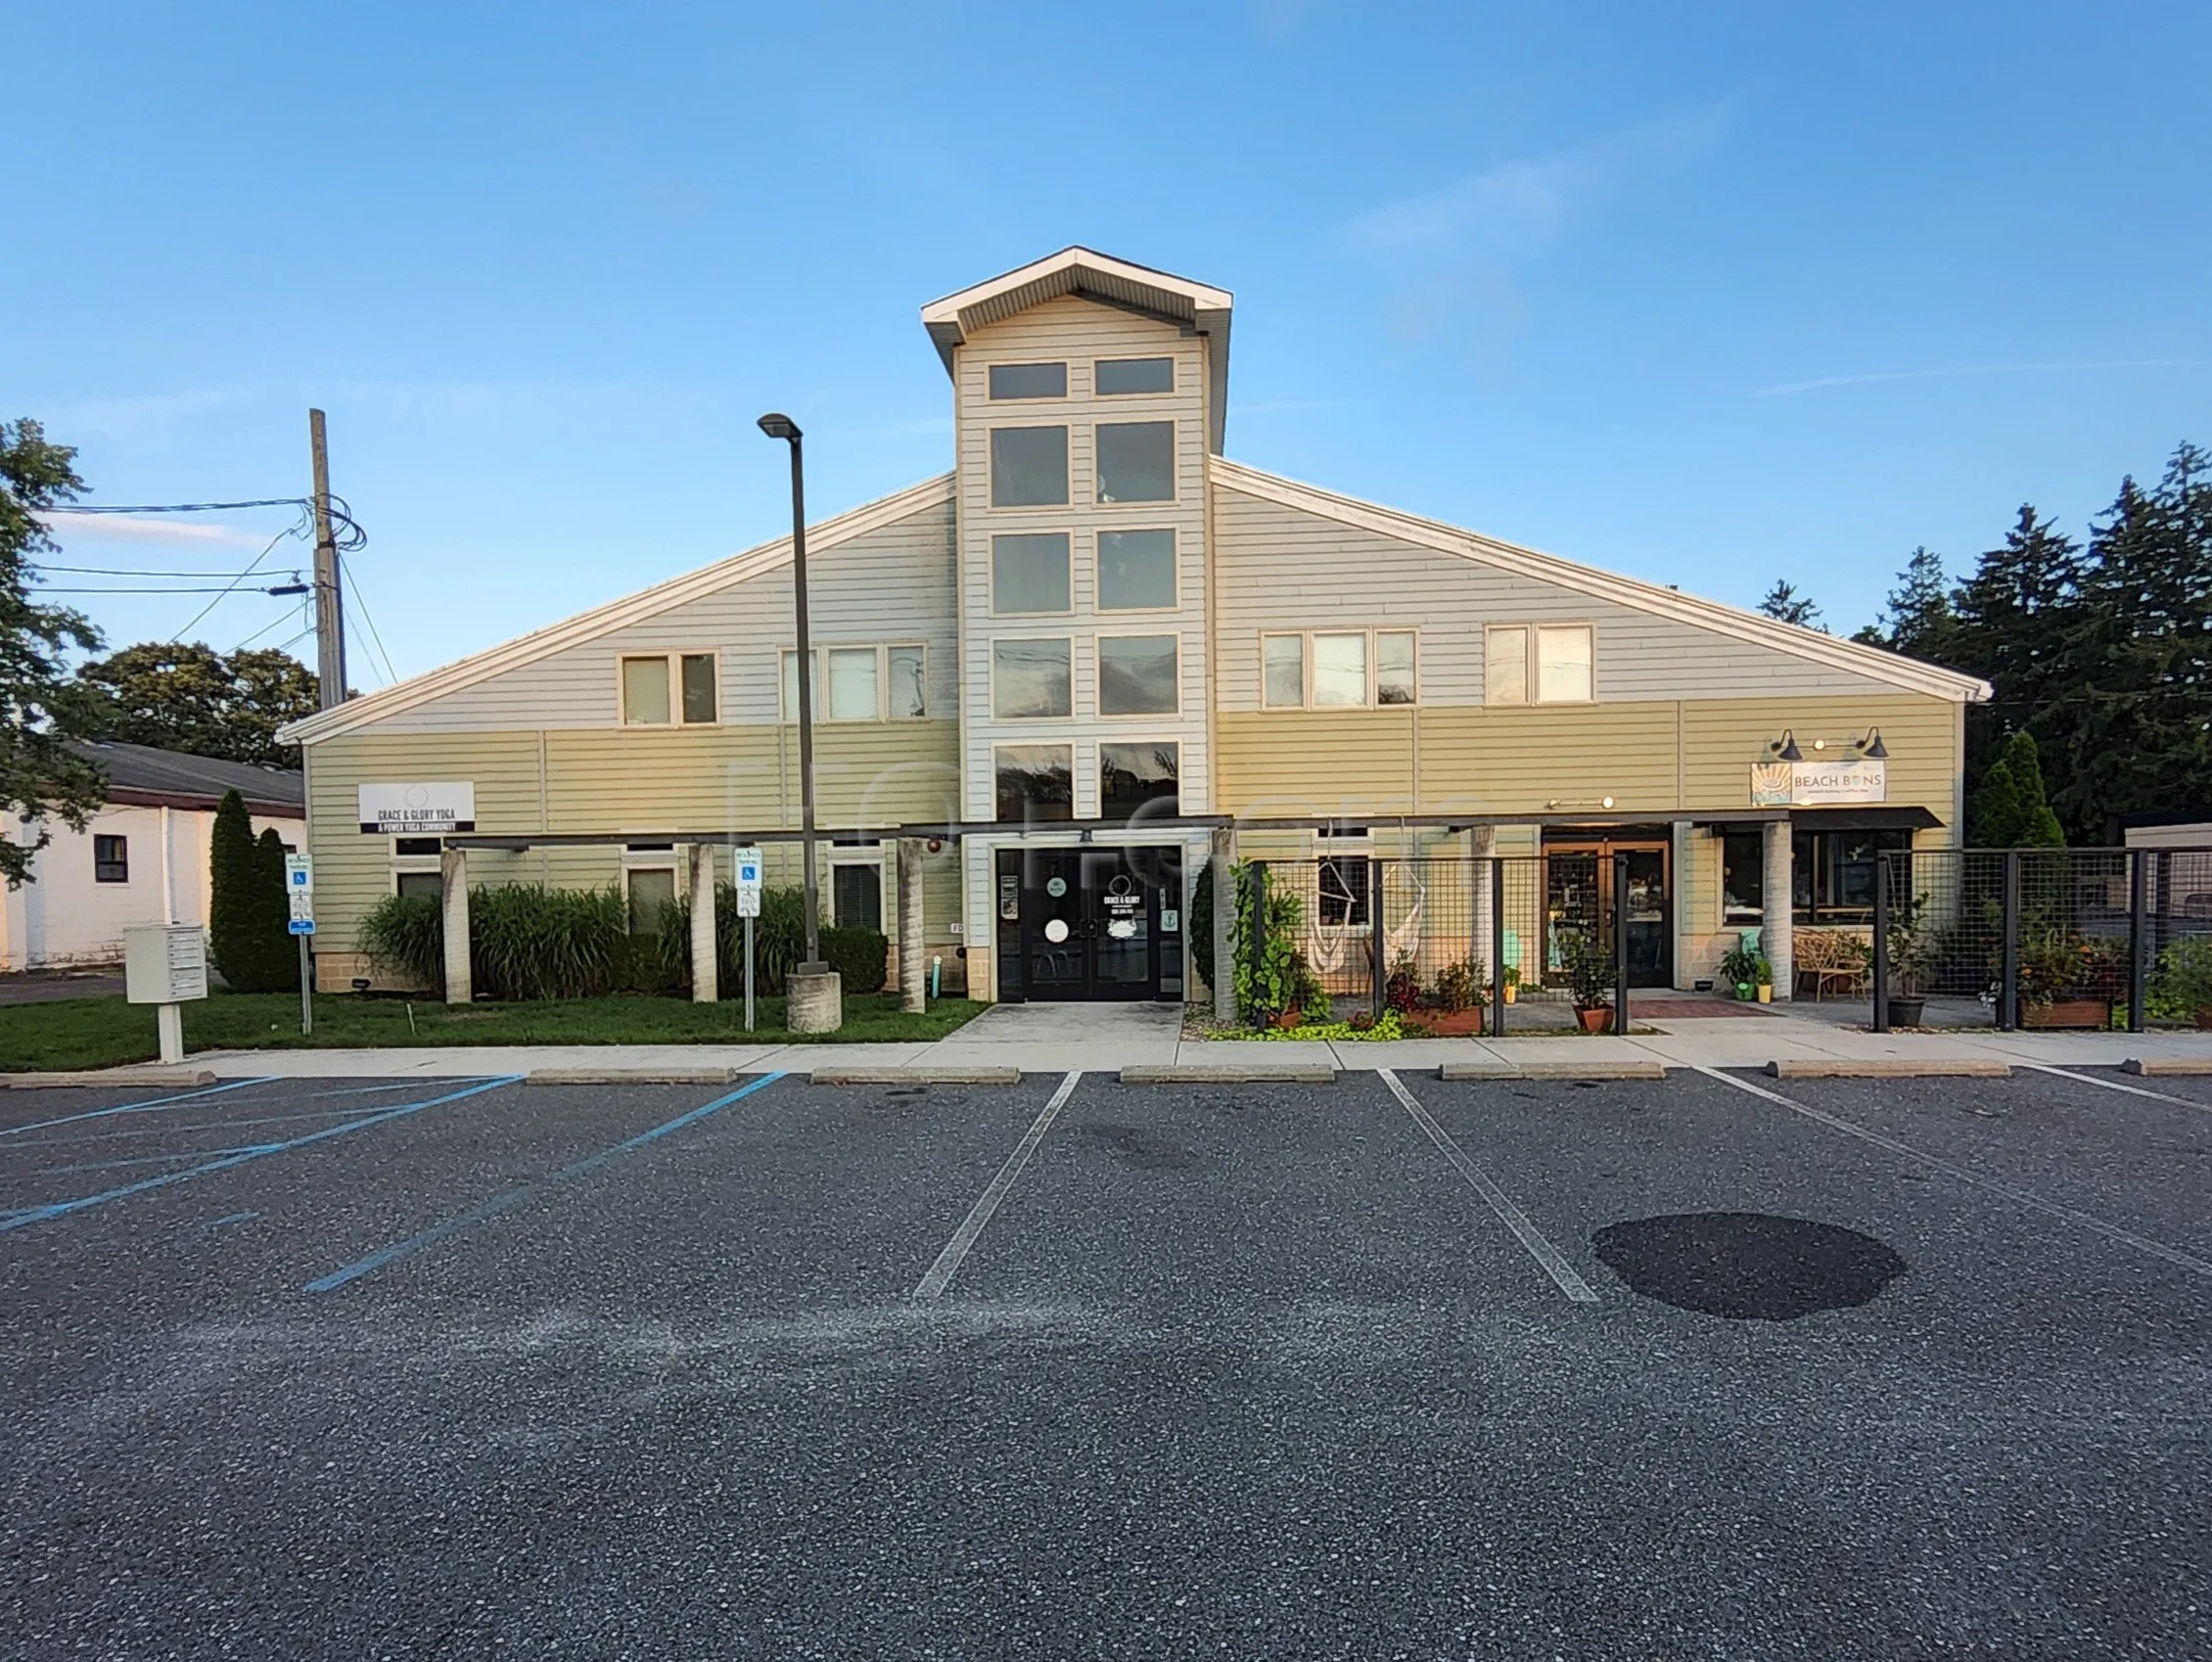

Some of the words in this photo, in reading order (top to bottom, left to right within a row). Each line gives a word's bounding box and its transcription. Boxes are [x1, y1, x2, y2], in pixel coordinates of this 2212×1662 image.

[1795, 775, 1838, 787] BEACH
[378, 809, 401, 820] GRACE
[411, 808, 434, 820] GLORY
[436, 808, 455, 819] YOGA
